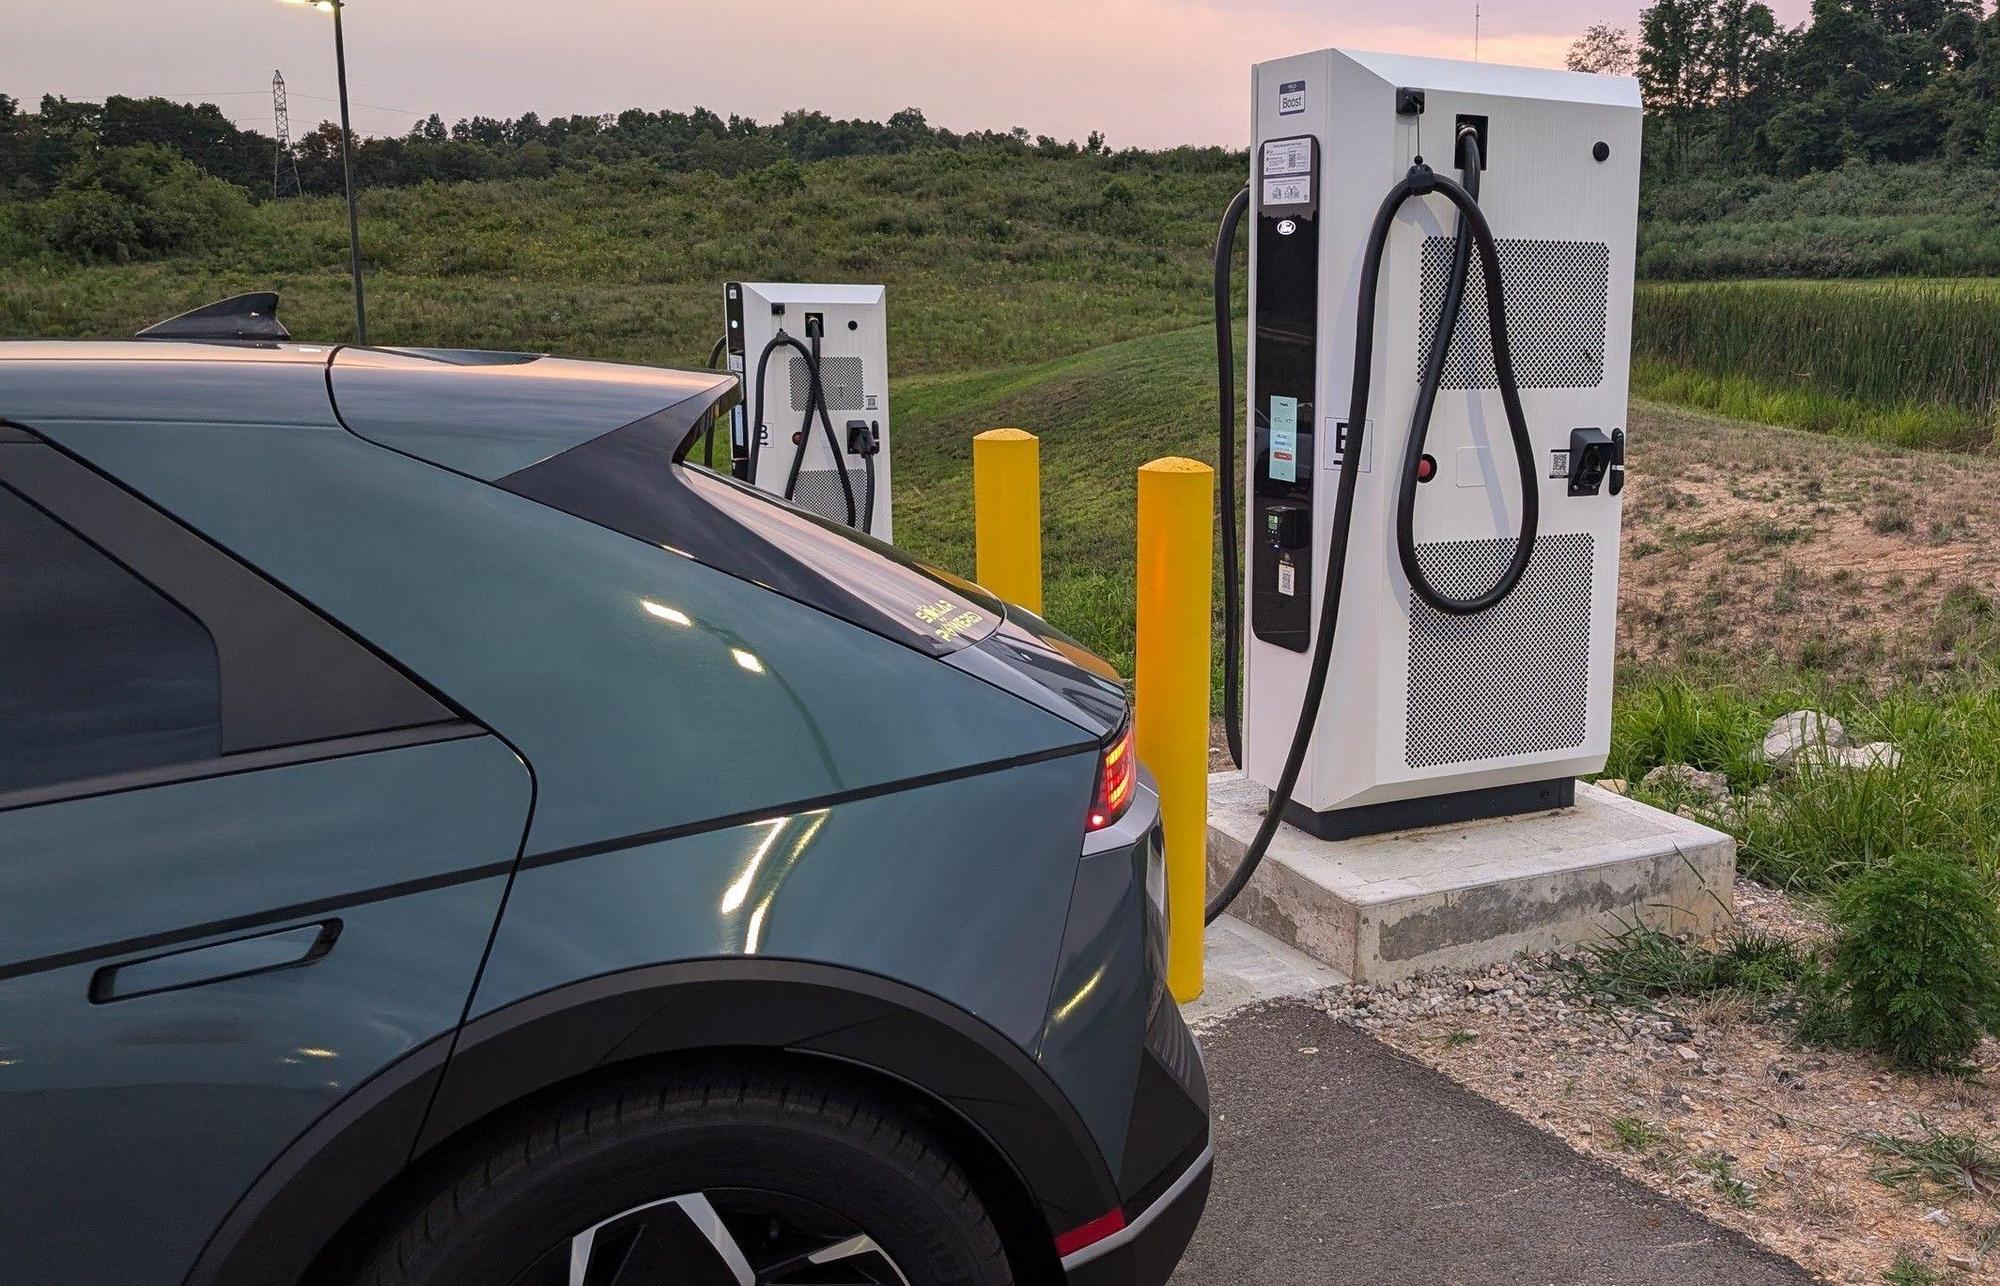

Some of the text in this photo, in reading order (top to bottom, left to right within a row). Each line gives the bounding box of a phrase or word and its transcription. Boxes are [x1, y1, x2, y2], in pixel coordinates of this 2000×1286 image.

[1282, 96, 1302, 109] Boost
[914, 599, 957, 624] SOLAR
[934, 611, 983, 642] POWERED
